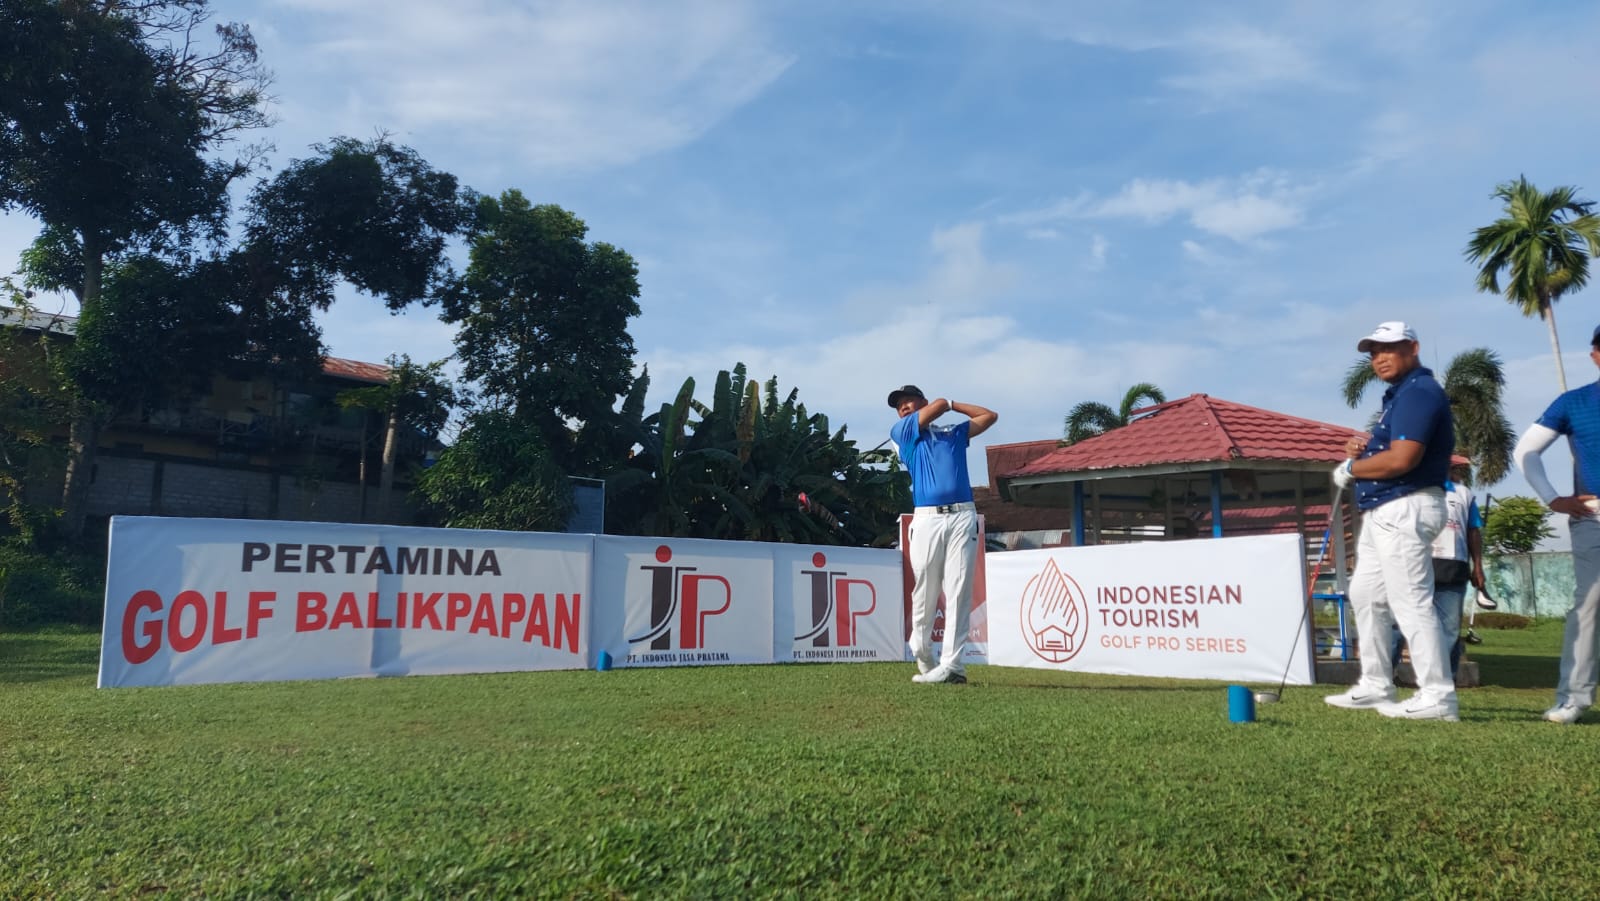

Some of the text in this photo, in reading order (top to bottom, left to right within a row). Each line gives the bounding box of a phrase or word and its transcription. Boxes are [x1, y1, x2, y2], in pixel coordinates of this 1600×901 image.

[242, 541, 502, 576] PERTAMINA
[1097, 584, 1242, 605] INDONESIAN
[121, 590, 581, 664] GOLF BALIKPAPAN
[1098, 608, 1199, 628] TOURISM
[1100, 634, 1247, 653] GOLF PRO SERIES
[679, 652, 695, 662] JASA
[697, 652, 730, 661] PRATAMA
